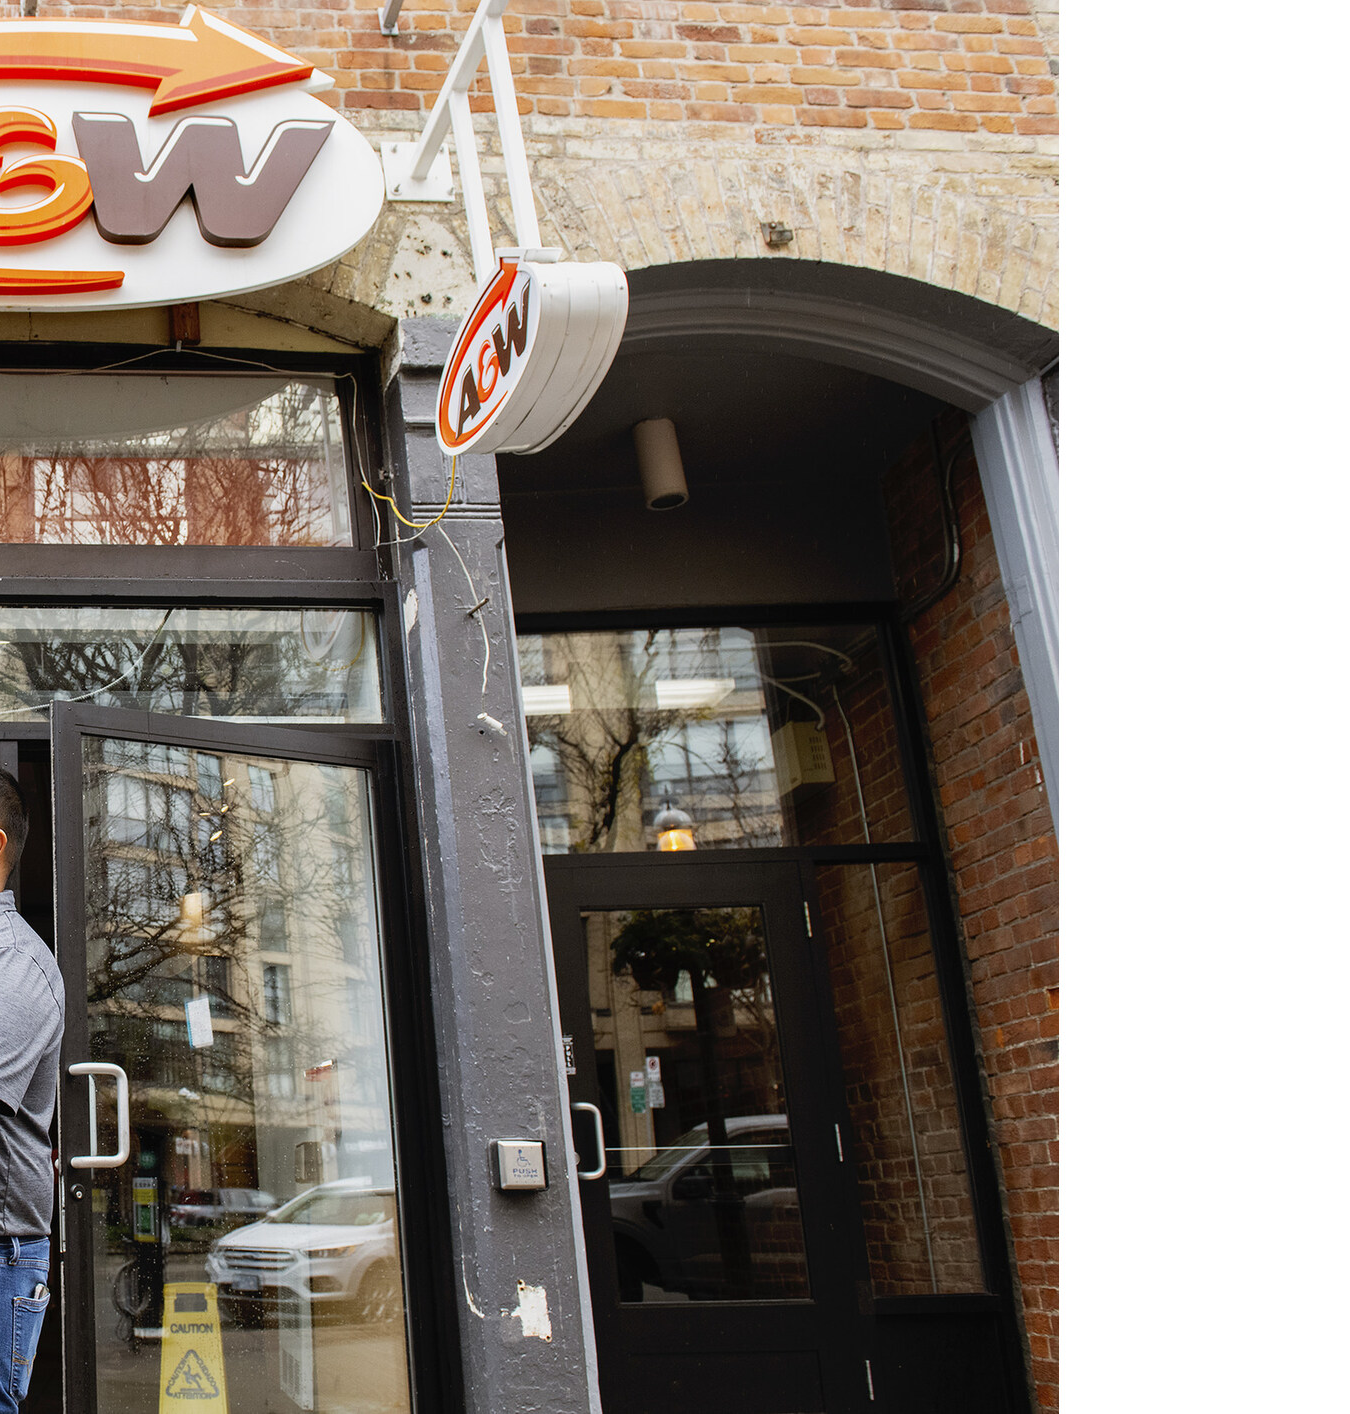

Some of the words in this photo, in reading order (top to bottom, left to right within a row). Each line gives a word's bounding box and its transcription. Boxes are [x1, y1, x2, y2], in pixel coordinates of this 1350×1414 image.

[455, 276, 531, 441] A&W
[169, 1322, 214, 1334] CAUTION
[168, 1358, 188, 1387] CAUTION
